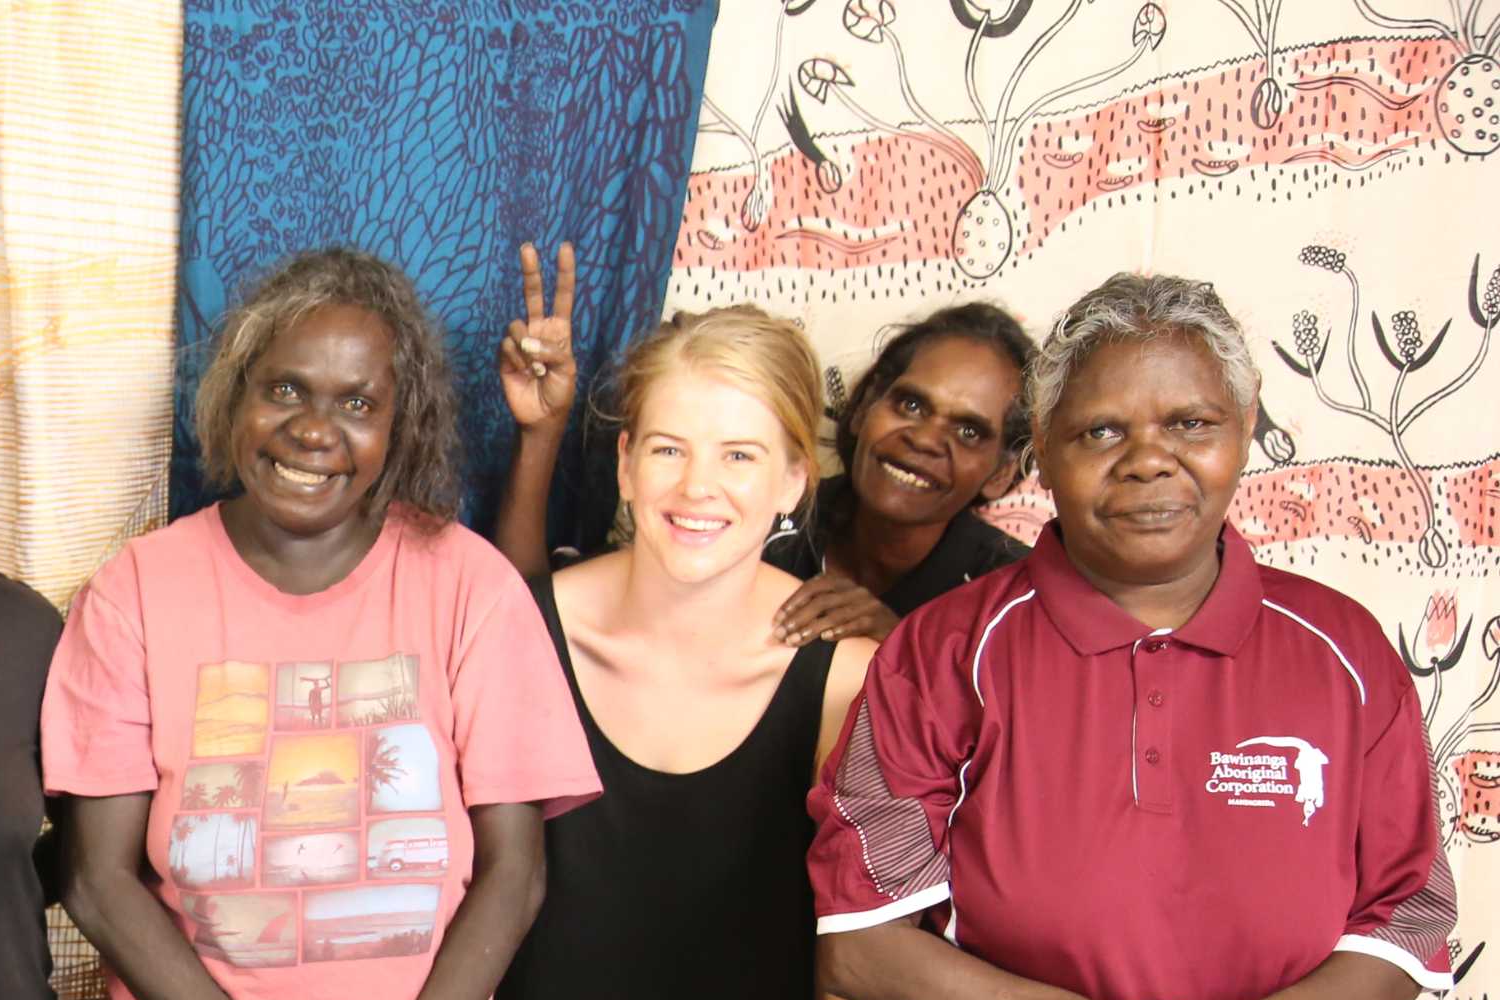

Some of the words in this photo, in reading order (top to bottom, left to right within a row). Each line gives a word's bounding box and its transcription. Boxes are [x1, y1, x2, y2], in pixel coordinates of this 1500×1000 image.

[1210, 752, 1287, 769] Bawinanga
[1212, 765, 1287, 782] Aboriginal
[1206, 780, 1293, 795] Corporation
